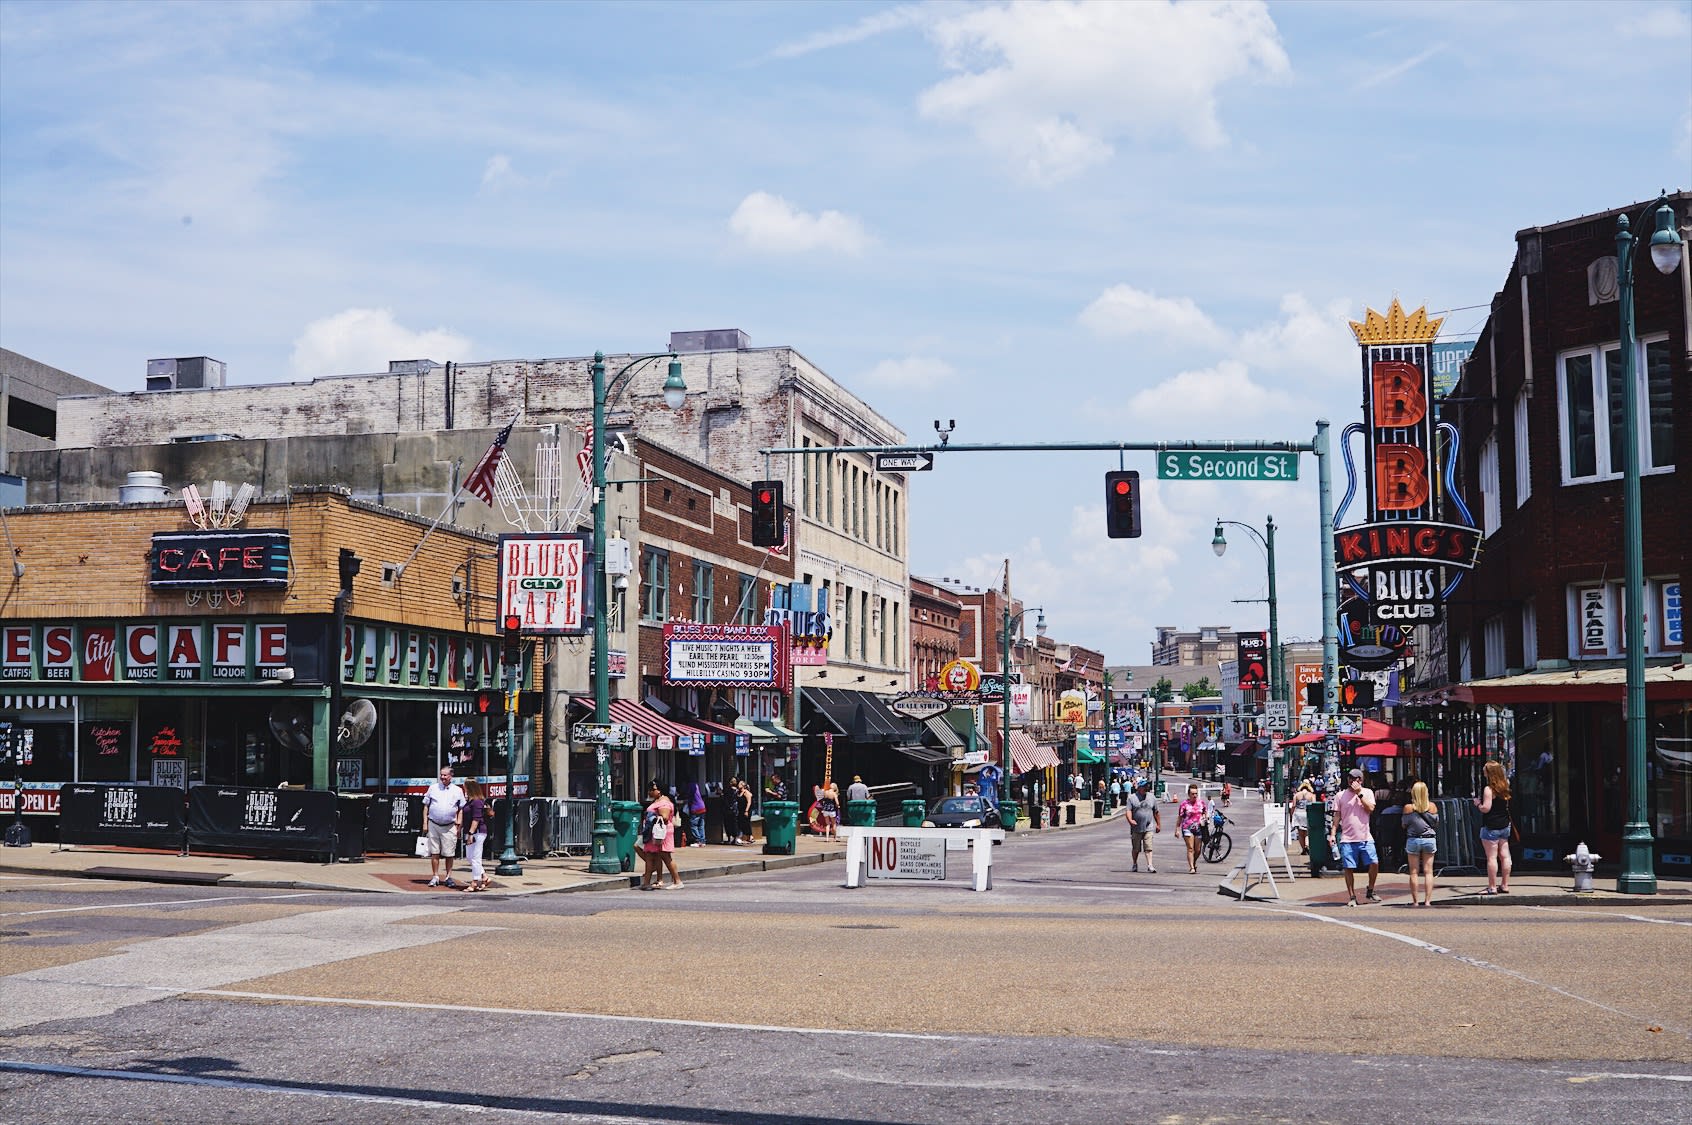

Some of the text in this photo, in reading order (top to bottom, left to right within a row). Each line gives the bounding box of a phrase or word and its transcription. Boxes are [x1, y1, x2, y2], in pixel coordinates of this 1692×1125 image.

[1373, 361, 1426, 428] B
[882, 459, 917, 467] ONE WAY
[1165, 455, 1291, 478] S. Second St.
[1377, 444, 1429, 511] B
[1339, 527, 1465, 562] KING'S
[158, 546, 265, 572] CAFE
[507, 542, 579, 577] BLUES
[522, 578, 561, 588] CITY
[1375, 569, 1435, 601] BLUES
[506, 579, 577, 625] CAFE
[1376, 604, 1436, 619] CLUB
[1584, 591, 1604, 647] SALADS
[673, 625, 768, 635] BLUES CITY BAND BOX
[85, 633, 117, 676] City
[129, 626, 286, 665] CAFE
[682, 644, 694, 652] LIVE
[719, 653, 739, 661] PEARL
[697, 661, 729, 669] MISSISSIPPI
[730, 661, 752, 669] MORRIS
[754, 662, 770, 670] 5PM
[47, 668, 70, 678] BEER
[128, 668, 158, 678] MUSIC
[175, 669, 193, 679] FUN
[213, 667, 246, 678] LIQUOR
[262, 668, 279, 678] RIB
[686, 669, 770, 678] HILLBILLY CASINO 930PM
[1268, 717, 1287, 727] 25
[91, 727, 121, 736] Kitchen
[96, 736, 118, 746] Open
[99, 745, 119, 754] Late
[156, 761, 182, 773] BLUES
[339, 759, 360, 772] LUES
[21, 794, 44, 810] OPEN
[108, 791, 133, 803] BLUES
[250, 794, 274, 806] BLUES
[107, 803, 133, 819] CAFE
[248, 805, 273, 822] CAFE
[873, 837, 897, 871] NO
